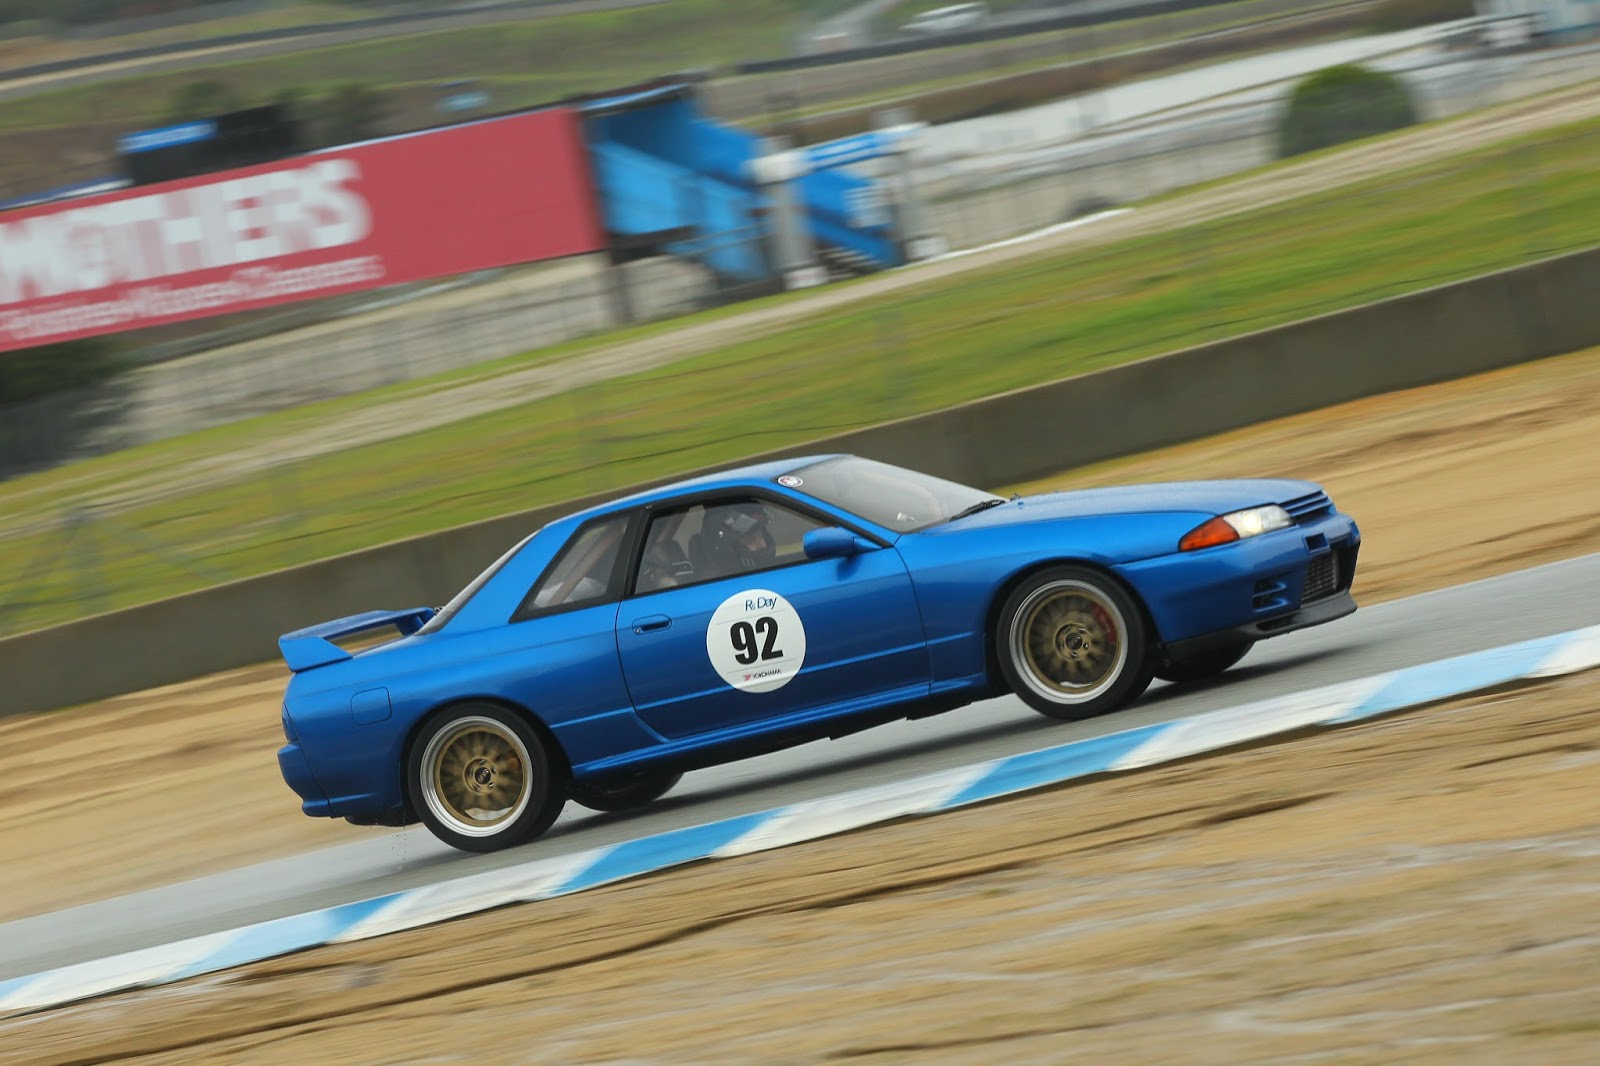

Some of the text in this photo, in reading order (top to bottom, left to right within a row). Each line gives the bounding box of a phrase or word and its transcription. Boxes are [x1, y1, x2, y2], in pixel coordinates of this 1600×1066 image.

[757, 597, 777, 610] Day
[730, 616, 783, 664] 92
[753, 668, 781, 679] YOKOHAMA
